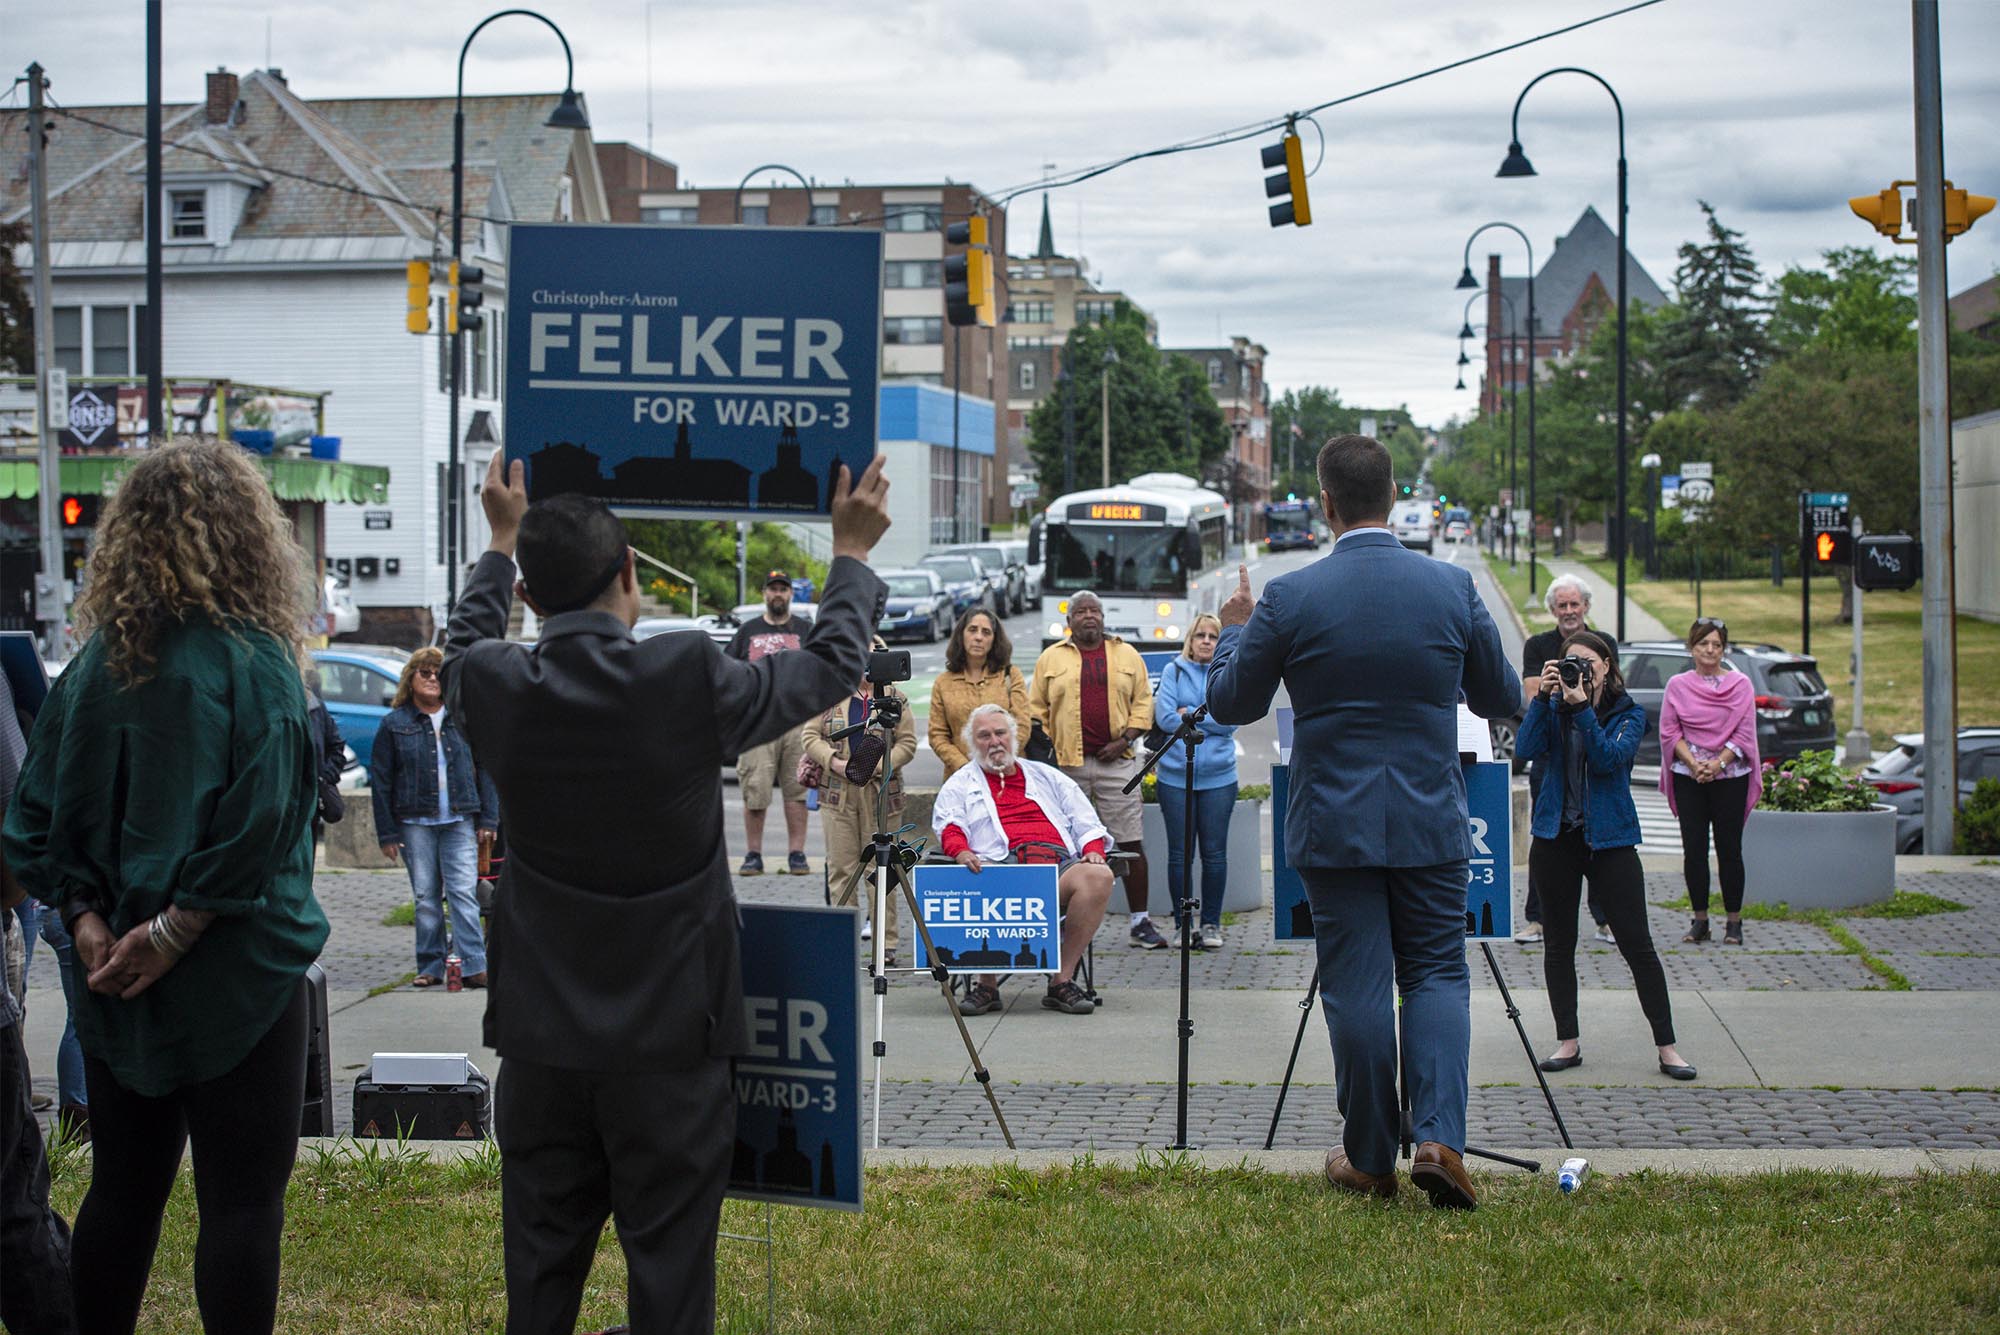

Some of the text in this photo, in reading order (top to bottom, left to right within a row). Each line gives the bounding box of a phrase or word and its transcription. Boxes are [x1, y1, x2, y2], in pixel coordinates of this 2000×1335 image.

[532, 290, 678, 307] Christopher-Aaron
[529, 312, 849, 380] FELKER
[633, 397, 850, 429] FOR WARD-3
[923, 890, 981, 898] Christopher-Aaron
[923, 898, 1048, 921] FELKER
[965, 928, 1049, 939] FOR WARD-3
